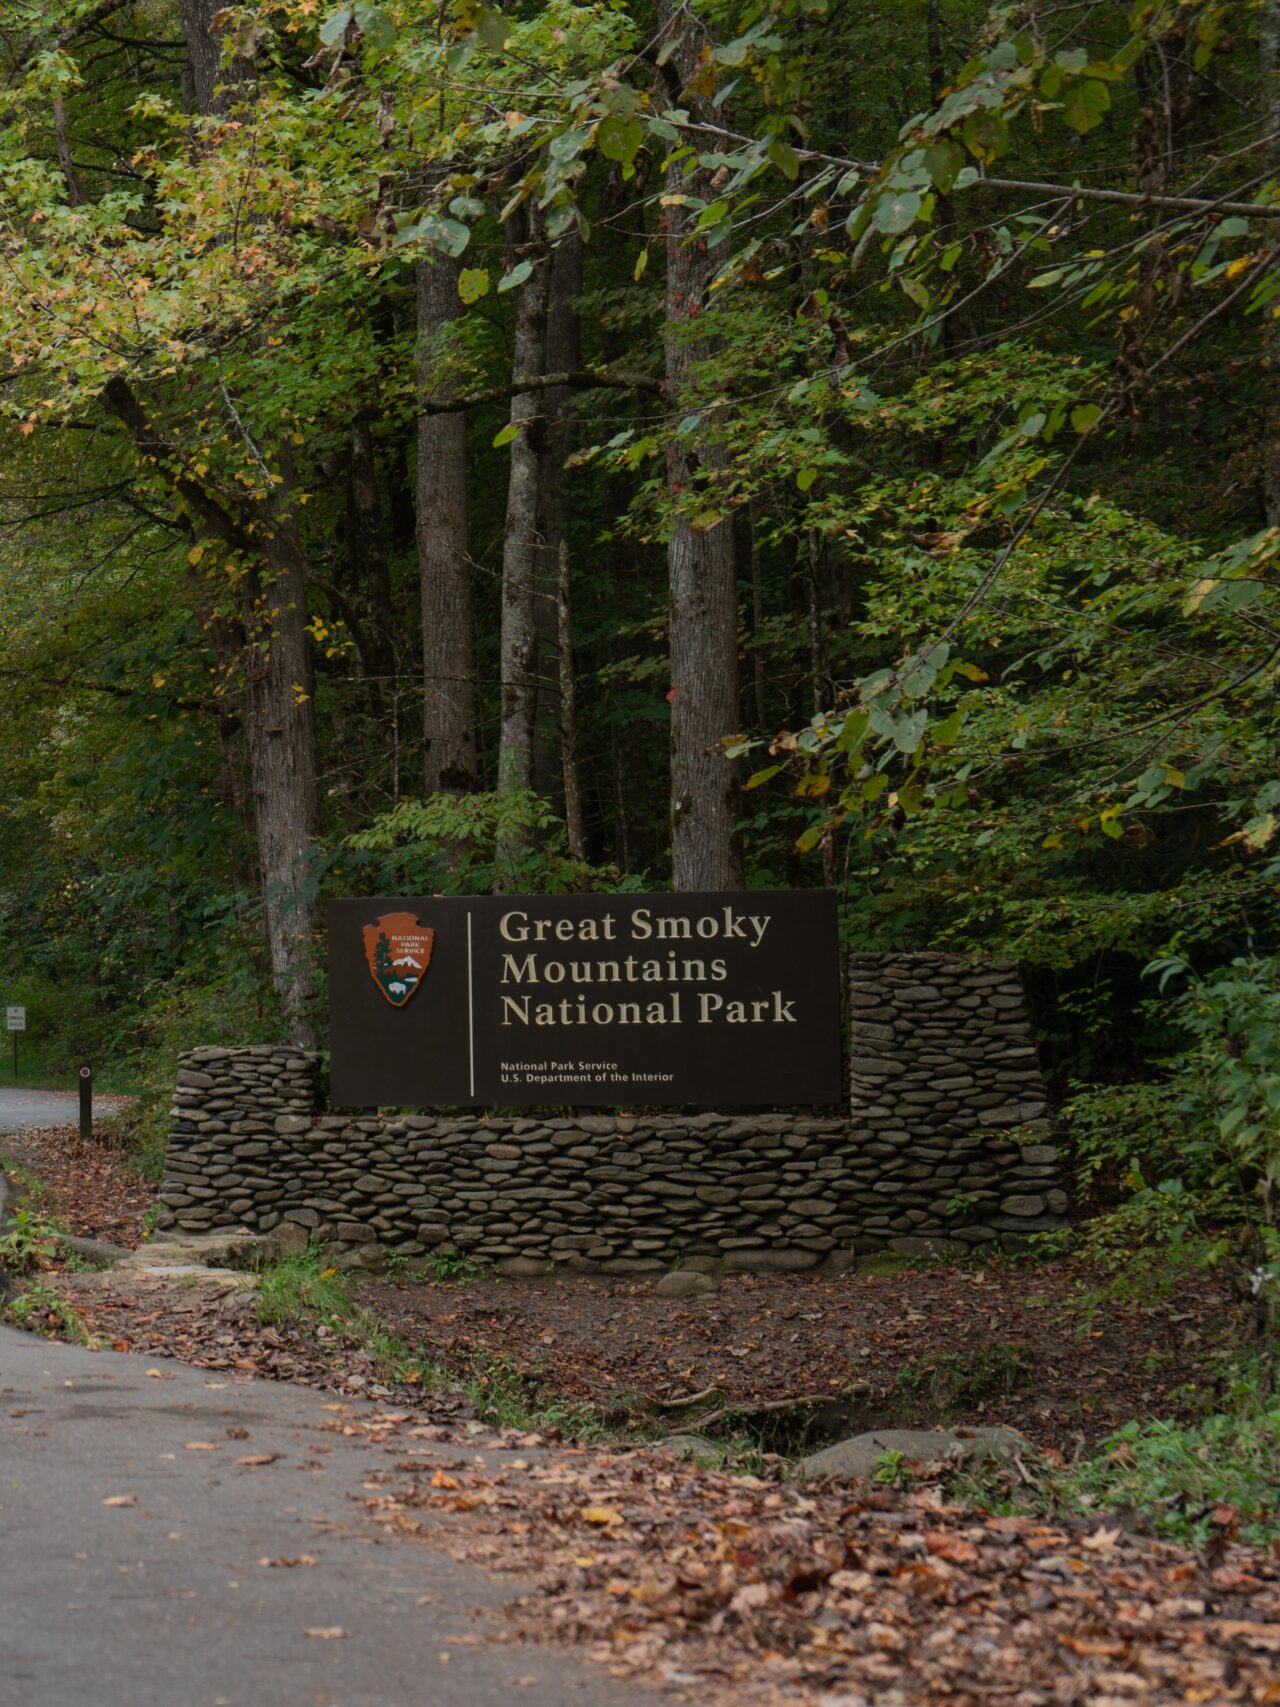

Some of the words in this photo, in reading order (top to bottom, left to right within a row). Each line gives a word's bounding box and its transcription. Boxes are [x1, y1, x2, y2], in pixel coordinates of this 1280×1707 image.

[500, 911, 617, 942] Great
[631, 906, 772, 948] Smoky
[500, 950, 727, 984] Mountains
[500, 991, 684, 1026] National
[697, 990, 797, 1023] Park
[500, 1061, 548, 1071] National
[550, 1061, 575, 1071] Park
[578, 1060, 618, 1071] Service
[500, 1073, 522, 1083] U.S.
[526, 1073, 592, 1084] Department
[594, 1072, 607, 1082] of
[610, 1072, 629, 1082] the
[631, 1072, 674, 1082] Interior
